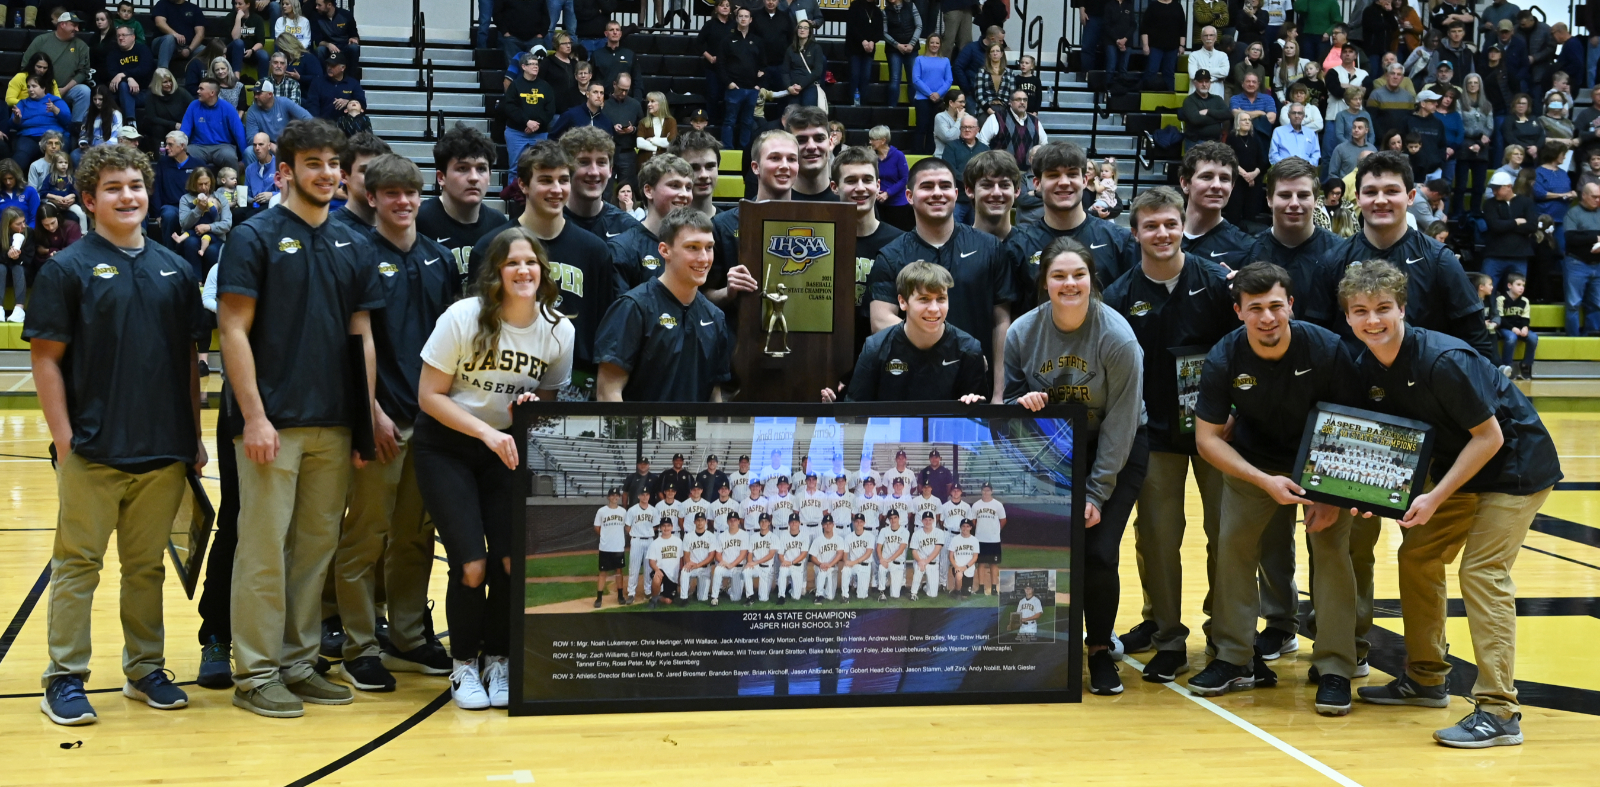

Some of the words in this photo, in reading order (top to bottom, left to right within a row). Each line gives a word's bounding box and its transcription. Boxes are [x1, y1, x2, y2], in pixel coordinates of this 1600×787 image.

[770, 236, 826, 259] IHSAA
[1058, 355, 1088, 373] STATE
[1324, 418, 1361, 431] JASPER
[1366, 426, 1418, 443] BASEBALL
[1351, 431, 1374, 443] STATE
[1376, 436, 1417, 452] CHAMPIONS
[743, 612, 762, 620] 2021
[764, 612, 774, 620] 4A
[776, 612, 802, 620] STATE
[805, 611, 856, 620] CHAMPIONS
[750, 622, 779, 630] JASPER
